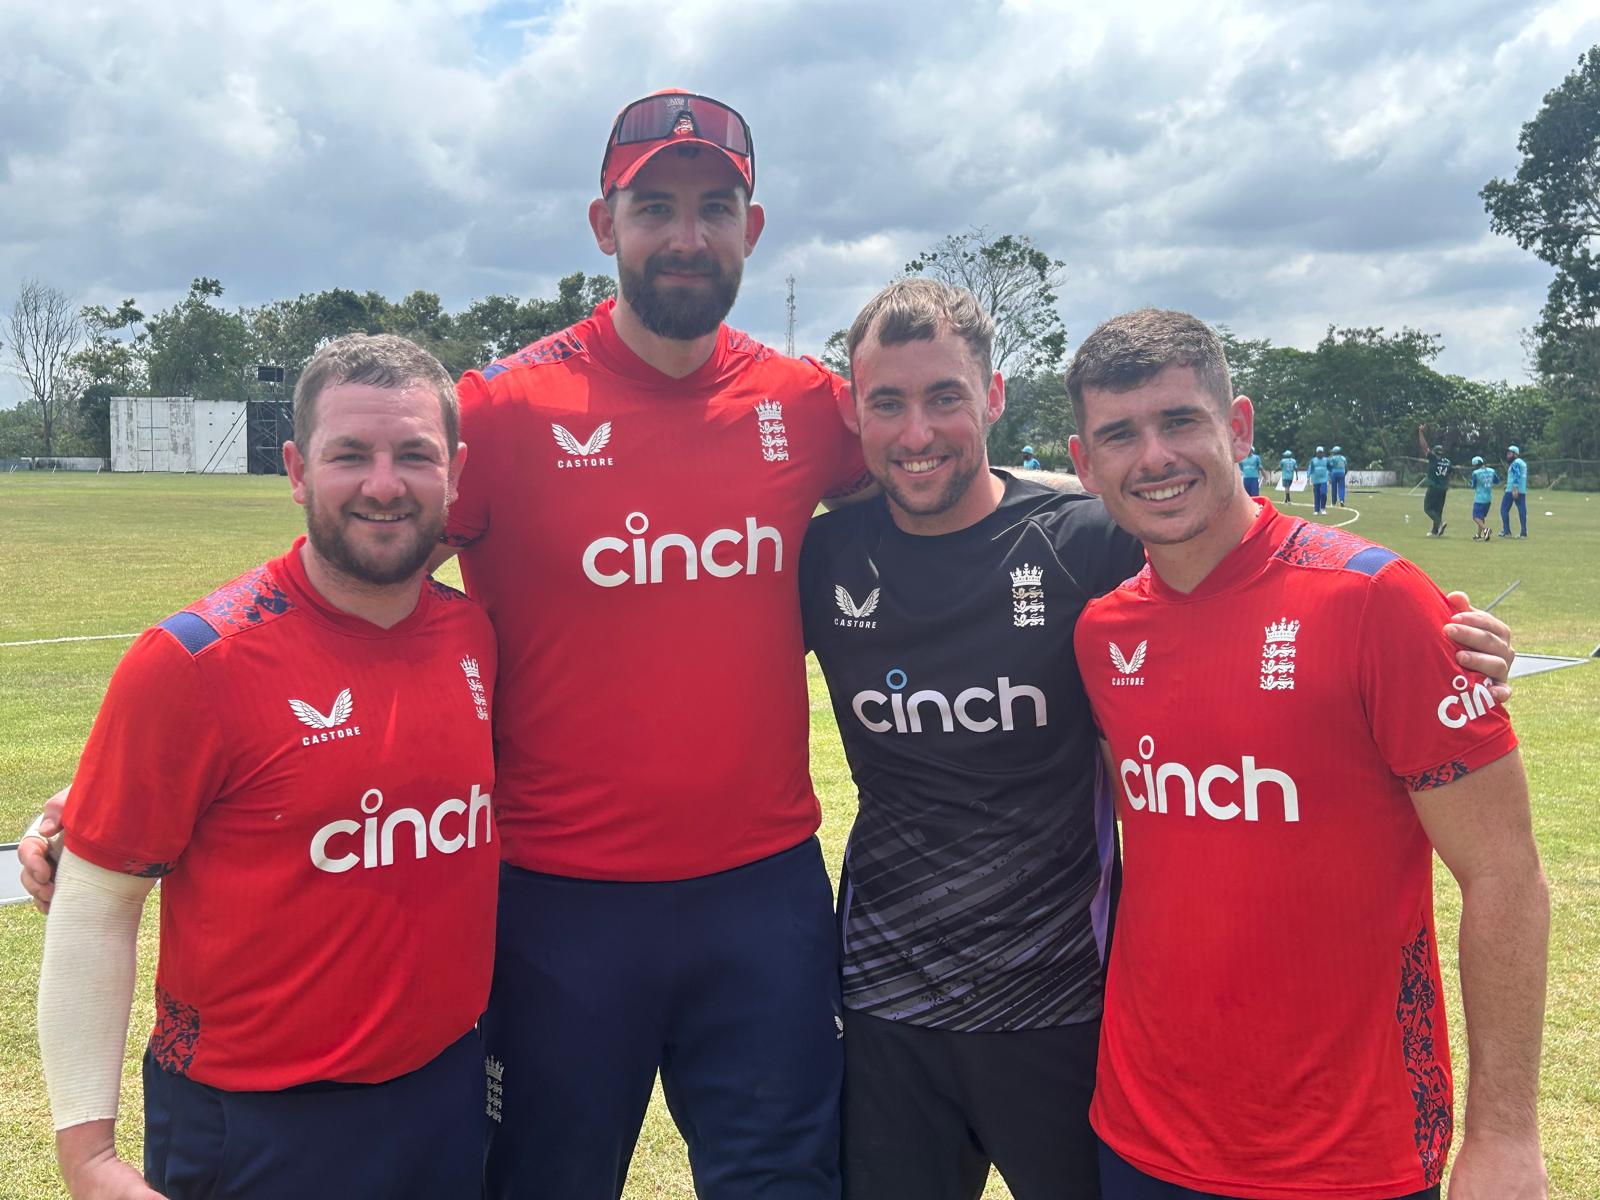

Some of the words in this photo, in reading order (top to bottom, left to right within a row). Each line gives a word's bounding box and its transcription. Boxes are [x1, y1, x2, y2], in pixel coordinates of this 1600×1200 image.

[557, 457, 614, 469] CASTORE
[1435, 466, 1448, 477] 34
[582, 511, 783, 588] cinch
[834, 618, 877, 629] CASTORE
[1111, 676, 1145, 686] CASTORE
[852, 668, 1048, 734] cinch
[302, 726, 361, 746] CASTORE
[1120, 734, 1300, 822] cinch
[309, 783, 492, 873] cinch
